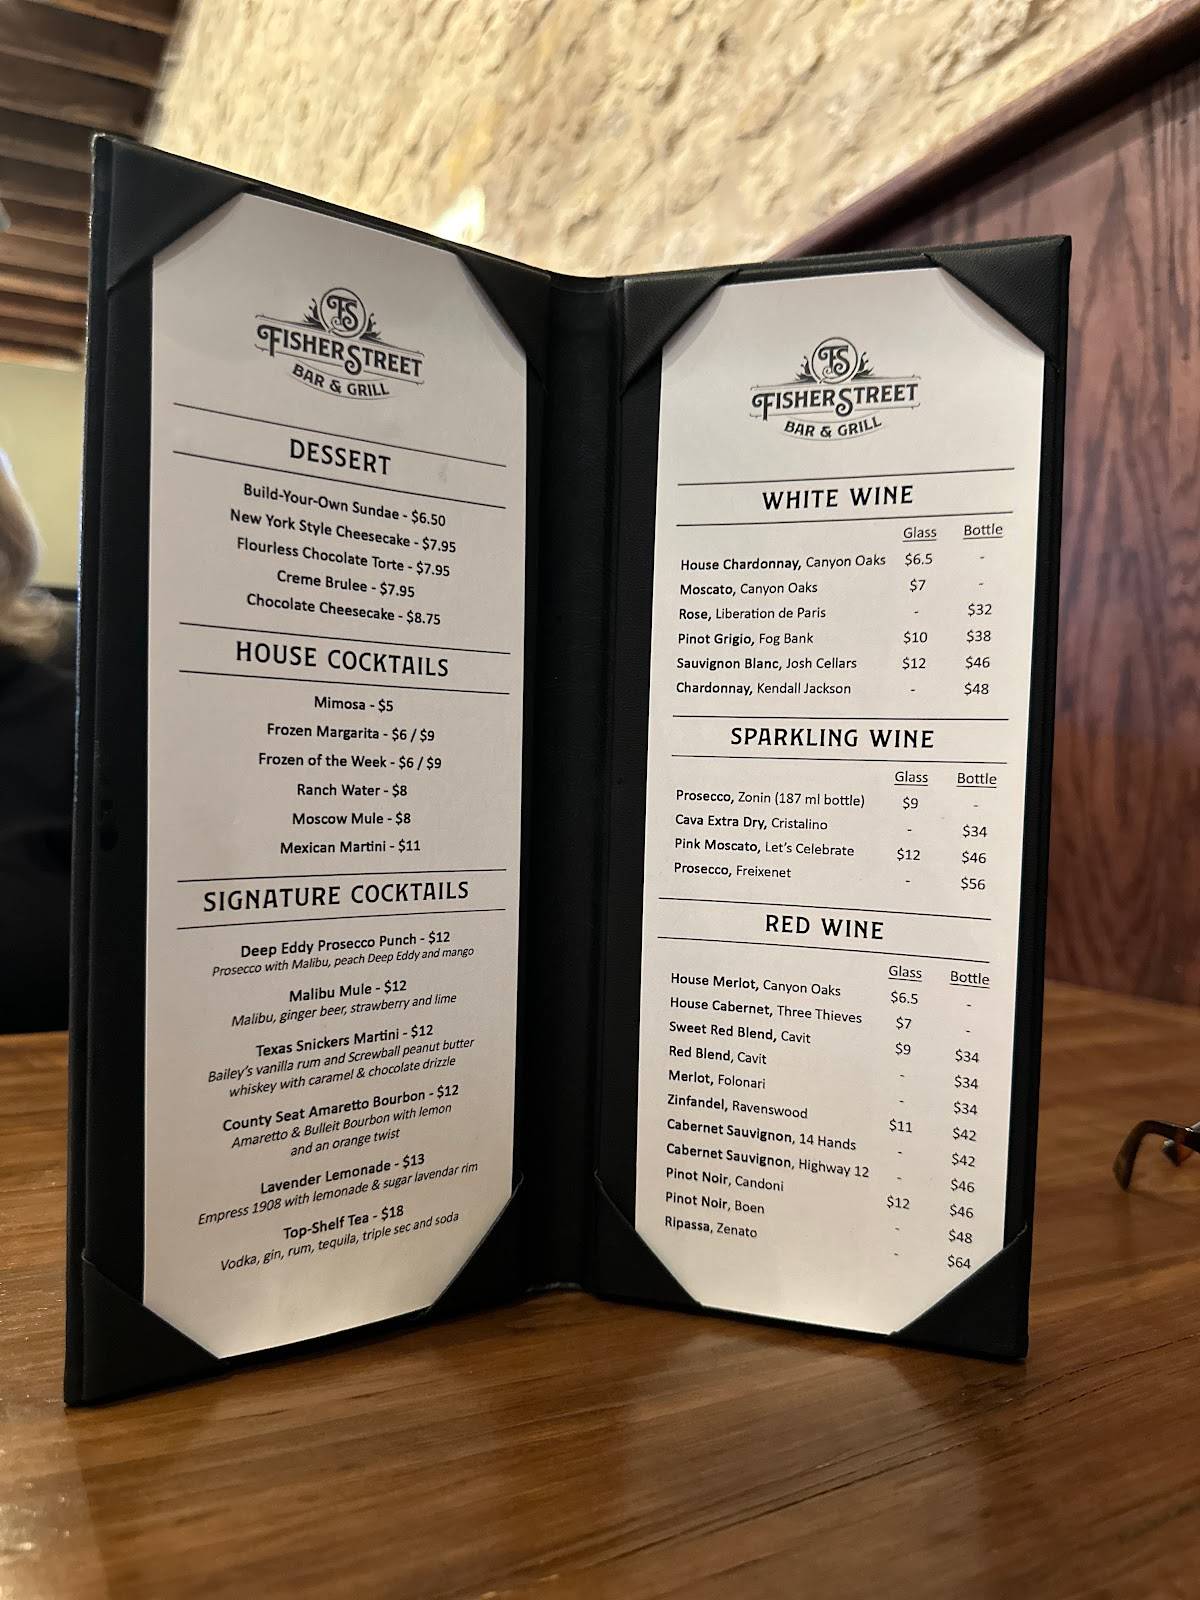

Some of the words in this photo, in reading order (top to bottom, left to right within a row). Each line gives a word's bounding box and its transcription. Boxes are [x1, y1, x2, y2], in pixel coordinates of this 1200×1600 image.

[293, 364, 324, 388] BAR
[330, 380, 342, 393] &
[347, 384, 389, 396] GRILL
[784, 420, 815, 437] BAR
[820, 426, 832, 438] &
[838, 417, 882, 436] GRILL
[290, 438, 391, 475] DESSERT
[244, 483, 348, 512] Build-Your-Own
[352, 501, 400, 520] Sundae
[411, 509, 446, 527] $6.50
[762, 489, 838, 510] WHITE
[850, 485, 913, 506] WINE
[230, 508, 262, 525] New
[265, 514, 296, 530] York
[299, 519, 332, 536] Style
[336, 525, 410, 547] Cheesecake
[422, 536, 456, 553] $7.95
[902, 526, 936, 540] Glass
[963, 523, 1003, 538] Bottle
[238, 536, 299, 557] Flourless
[302, 546, 368, 566] Chocolate
[371, 556, 404, 571] Torte
[416, 560, 450, 576] $7.95
[681, 560, 719, 570] House
[723, 557, 802, 571] Chardonnay,
[806, 557, 851, 570] Canyon
[855, 554, 886, 566] Oaks
[905, 552, 932, 567] $6.5
[277, 570, 321, 587] Creme
[325, 576, 368, 592] Brulee
[380, 580, 414, 598] $7.95
[246, 593, 315, 612] Chocolate
[319, 602, 394, 620] Cheesecake
[406, 610, 440, 625] $8.75
[680, 608, 711, 622] Rose,
[716, 608, 774, 622] Liberation
[778, 606, 793, 618] de
[798, 607, 826, 618] Paris
[968, 603, 992, 617] $32
[678, 633, 710, 644] Pinot
[714, 632, 754, 646] Grigio,
[760, 633, 780, 646] Fog
[784, 632, 813, 647] Bank
[904, 630, 928, 644] $10
[966, 629, 991, 644] $38
[236, 640, 316, 667] HOUSE
[328, 650, 448, 677] COCKTAILS
[314, 696, 366, 710] Mimosa
[378, 698, 393, 714] $5
[268, 723, 312, 736] Frozen
[316, 725, 379, 741] Margarita
[392, 727, 407, 742] $6
[420, 728, 434, 743] $9
[731, 728, 858, 747] SPARKLING
[869, 729, 934, 748] WINE
[259, 752, 304, 766] Frozen
[308, 754, 323, 766] of
[325, 753, 348, 767] the
[350, 755, 387, 768] Week
[398, 754, 414, 770] $6
[426, 756, 441, 770] $9
[894, 770, 928, 784] Glass
[956, 772, 997, 786] Bottle
[297, 783, 337, 796] Ranch
[340, 784, 380, 796] Water
[392, 783, 407, 798] $8
[677, 790, 734, 804] Prosecco,
[738, 792, 770, 803] Zonin
[775, 792, 801, 806] (187
[805, 794, 820, 805] ml
[824, 794, 864, 808] bottle)
[903, 796, 918, 810] $9
[292, 812, 348, 824] Moscow
[352, 812, 384, 824] Mule
[395, 811, 411, 826] $8
[676, 814, 704, 826] Cava
[708, 815, 739, 827] Extra
[744, 816, 767, 832] Dry,
[772, 818, 828, 830] Cristalino
[962, 824, 988, 838] $34
[280, 842, 335, 854] Mexican
[340, 840, 386, 853] Martini
[398, 838, 420, 853] $11
[674, 862, 732, 878] Prosecco,
[736, 865, 791, 878] Freixenet
[961, 876, 985, 890] $56
[204, 886, 340, 912] SIGNATURE
[350, 881, 468, 904] COCKTAILS
[766, 914, 810, 934] RED
[821, 918, 884, 940] WINE
[241, 946, 277, 958] Deep
[281, 940, 314, 955] Eddy
[318, 939, 375, 952] Prosecco
[378, 933, 416, 947] Punch
[428, 930, 450, 946] $12
[212, 965, 262, 976] Prosecco
[264, 960, 288, 972] with
[291, 957, 331, 970] Malibu,
[334, 952, 365, 968] peach
[368, 953, 394, 964] Deep
[396, 949, 420, 962] Eddy
[422, 946, 440, 958] and
[442, 948, 474, 958] mango
[888, 965, 922, 980] Glass
[949, 970, 990, 987] Bottle
[289, 987, 335, 1002] Malibu
[340, 981, 372, 998] Mule
[384, 980, 406, 996] $12
[671, 973, 709, 986] House
[713, 976, 759, 992] Merlot,
[763, 980, 807, 994] Canyon
[811, 984, 840, 996] Oaks
[891, 990, 918, 1004] $6.5
[255, 1044, 293, 1057] Texas
[294, 1036, 350, 1055] Snickers
[353, 1028, 399, 1043] Martini
[411, 1024, 434, 1041] $12
[223, 1114, 273, 1131] County
[275, 1108, 305, 1123] Seat
[308, 1099, 371, 1118] Amaretto
[373, 1090, 426, 1109] Bourbon
[436, 1084, 459, 1100] $12
[668, 1094, 728, 1112] Zinfandel,
[732, 1097, 808, 1119] Ravenswood
[667, 1118, 724, 1135] Cabernet
[726, 1124, 795, 1145] Sauvignon,
[800, 1133, 814, 1145] 14
[818, 1136, 856, 1150] Hands
[889, 1118, 912, 1133] $11
[952, 1126, 976, 1142] $42
[952, 1152, 975, 1168] $42
[260, 1174, 324, 1194] Lavender
[324, 1160, 391, 1183] Lemonade
[402, 1154, 424, 1172] $13
[666, 1167, 698, 1183] Pinot
[702, 1171, 732, 1188] Noir,
[735, 1176, 784, 1191] Candoni
[886, 1194, 910, 1210] $12
[950, 1203, 974, 1219] $46
[283, 1216, 345, 1240] Top-Shelf
[347, 1214, 370, 1228] Tea
[381, 1205, 404, 1222] $18
[665, 1216, 713, 1234] Ripassa,
[717, 1222, 757, 1238] Zenato
[948, 1254, 971, 1269] $64
